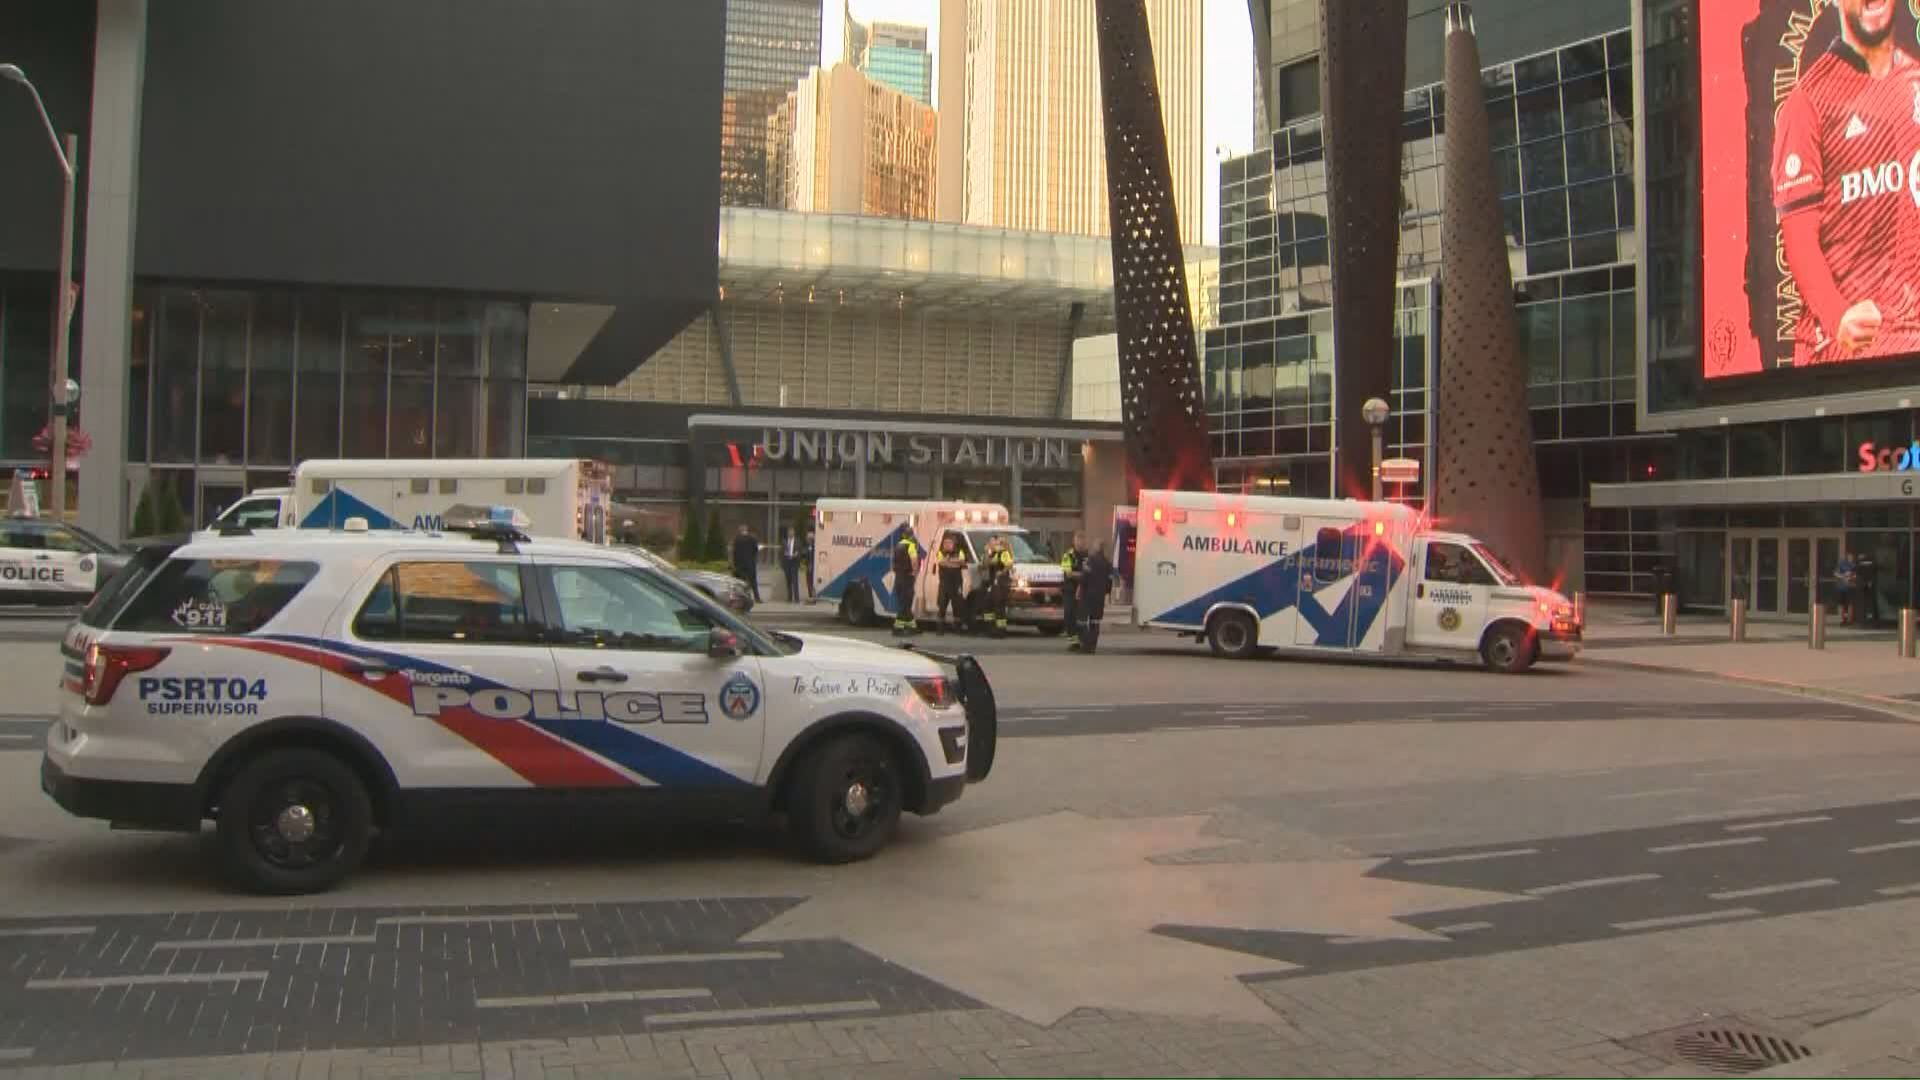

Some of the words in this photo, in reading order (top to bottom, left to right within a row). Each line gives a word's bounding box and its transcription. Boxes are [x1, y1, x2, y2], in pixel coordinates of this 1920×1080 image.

[1840, 160, 1904, 205] BMO
[763, 429, 894, 465] UNION
[909, 436, 1070, 468] STATION
[412, 514, 449, 531] AM
[831, 534, 873, 549] AMBULANCE
[1183, 534, 1288, 557] AMBULANCE
[0, 567, 64, 582] OLICE
[408, 669, 471, 685] Toronto
[793, 675, 806, 695] To
[811, 675, 841, 695] Serve
[847, 679, 859, 694] &
[867, 677, 901, 697] Protect
[139, 677, 267, 700] PSRT04
[147, 703, 258, 714] SUPERVISOR
[410, 684, 709, 724] POLICE
